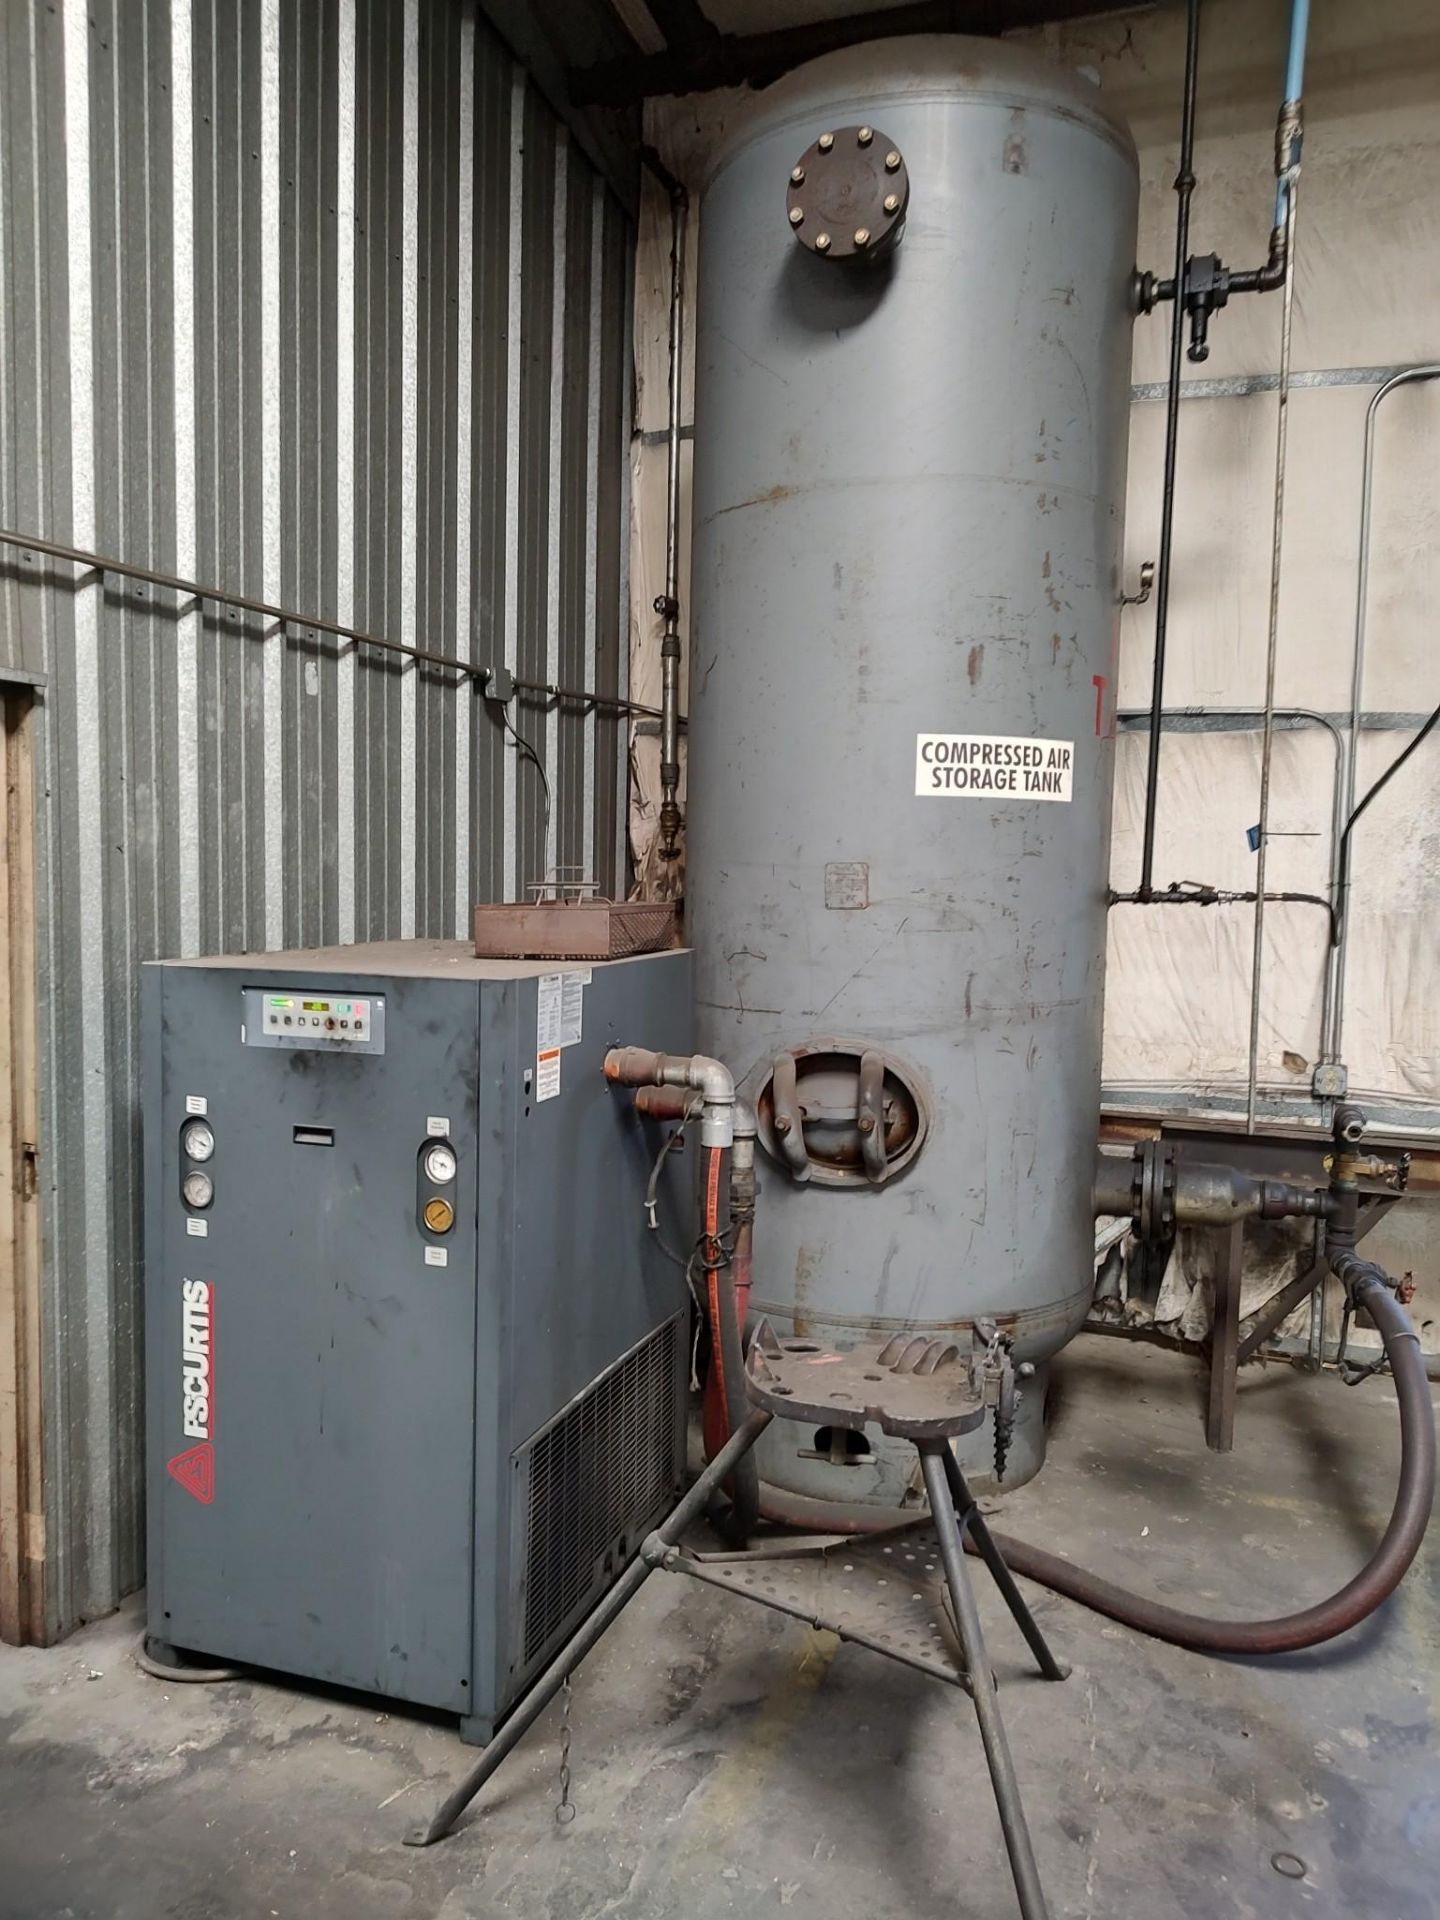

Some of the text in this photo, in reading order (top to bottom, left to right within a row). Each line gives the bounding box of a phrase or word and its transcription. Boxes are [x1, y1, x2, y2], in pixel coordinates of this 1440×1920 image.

[921, 741, 1070, 770] COMPRESSED AIR
[932, 766, 1062, 793] STORAGE TANK
[183, 1280, 210, 1439] FSCURTIS
